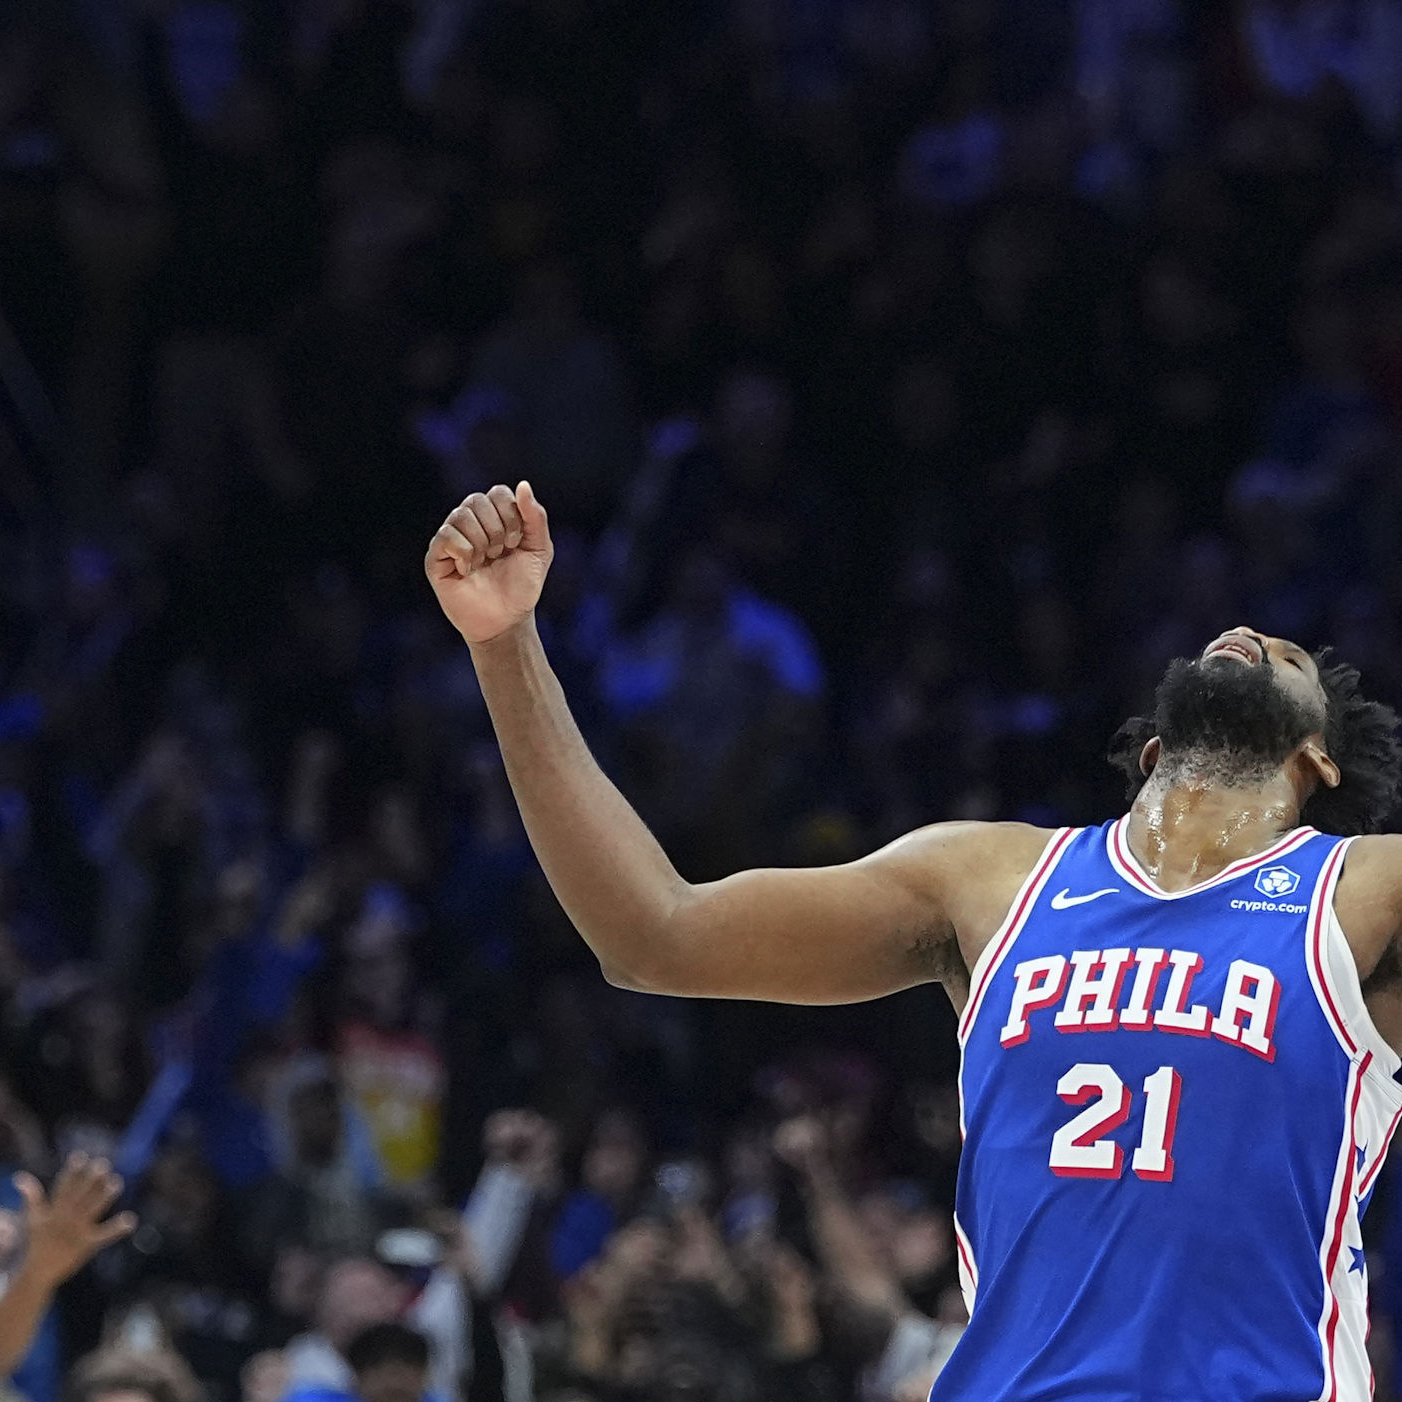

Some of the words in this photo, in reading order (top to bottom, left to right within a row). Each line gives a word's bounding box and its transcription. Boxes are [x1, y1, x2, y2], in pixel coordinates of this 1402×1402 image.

[1230, 899, 1308, 914] crypto.com
[1000, 947, 1283, 1063] PHILA
[1049, 1062, 1183, 1182] 21
